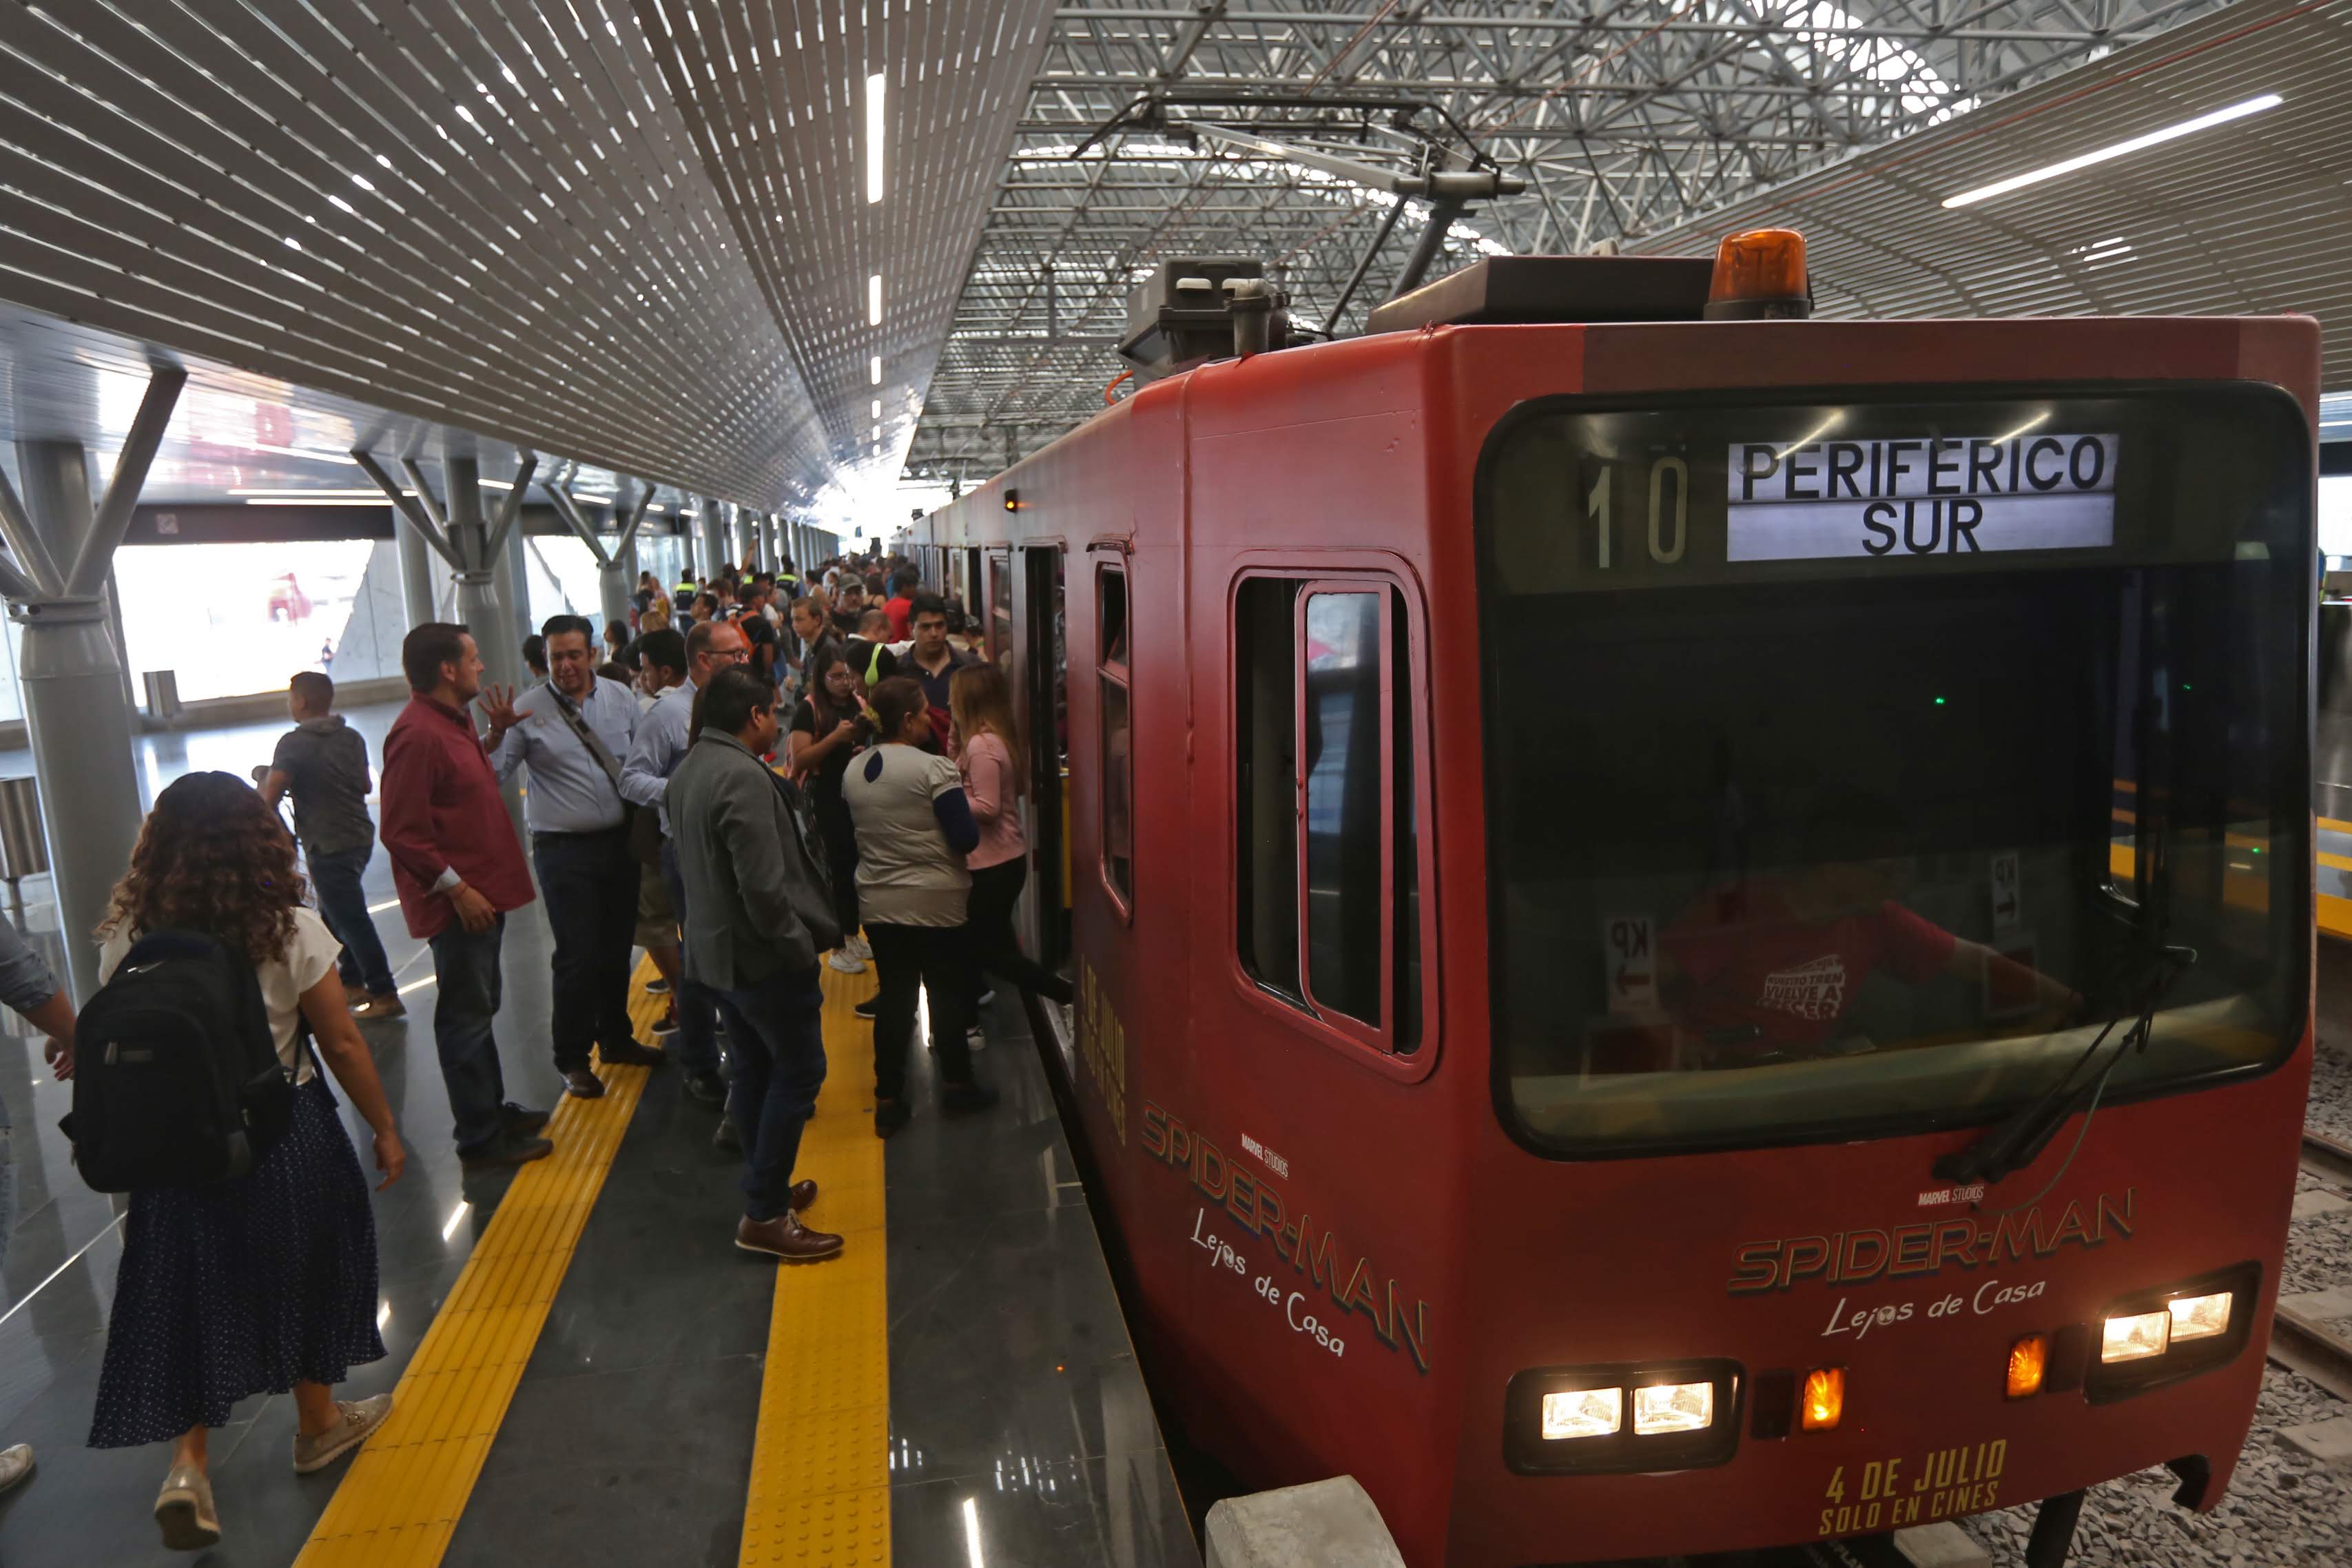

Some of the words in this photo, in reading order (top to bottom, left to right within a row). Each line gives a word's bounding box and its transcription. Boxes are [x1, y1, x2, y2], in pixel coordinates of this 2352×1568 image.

[1742, 435, 2106, 501] PERIFERICO
[1861, 497, 1983, 556] SUR
[1766, 985, 1819, 1001] VUELVE
[1241, 1133, 1263, 1161] MARVEL
[1264, 1148, 1288, 1178] STUDIOS
[1918, 1190, 1950, 1206] MARVEL
[1951, 1184, 1984, 1202] STUDIOS
[1142, 1100, 1431, 1372] SPIDER-MAN
[1726, 1186, 2138, 1292] SPIDER-MAN
[1190, 1207, 1246, 1275] Lejos
[1255, 1276, 1280, 1306] de
[1287, 1292, 1345, 1357] Casa
[1821, 1298, 1915, 1340] Lejos
[1928, 1294, 1963, 1319] de
[1972, 1280, 2046, 1314] Casa
[1826, 1465, 1845, 1504] 4
[1860, 1458, 1903, 1500] DE
[1913, 1438, 2008, 1492] JULIO
[1819, 1502, 1881, 1536] SOLO
[1891, 1495, 1921, 1525] EN
[1930, 1480, 1999, 1518] CINES
